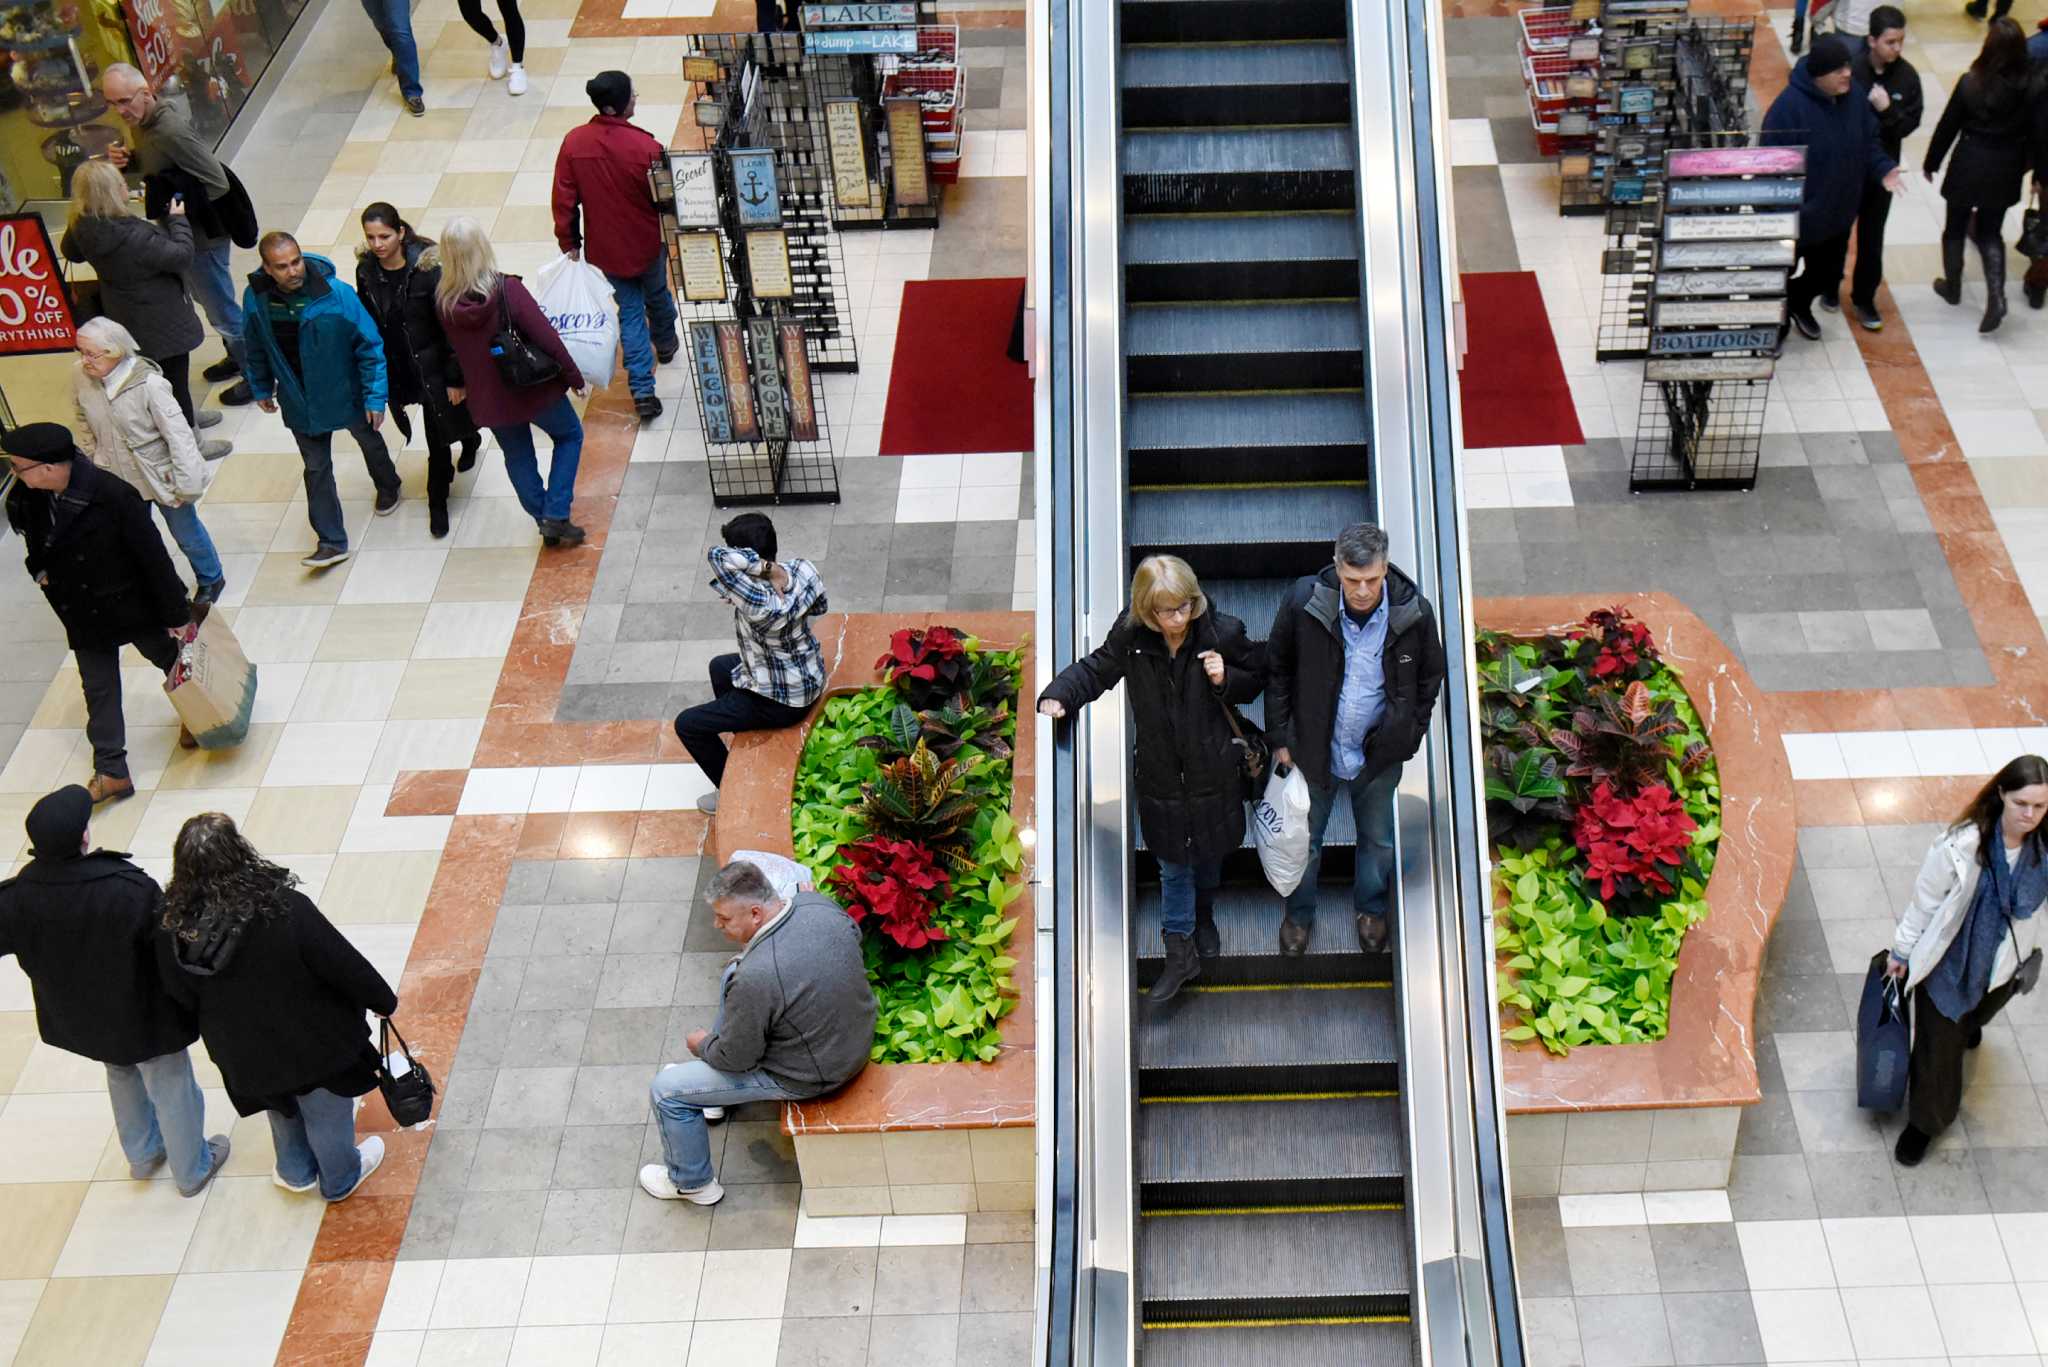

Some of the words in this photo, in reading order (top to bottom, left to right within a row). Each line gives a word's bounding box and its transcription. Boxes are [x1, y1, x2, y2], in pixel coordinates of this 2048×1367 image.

[822, 6, 893, 22] LAKE
[872, 34, 914, 48] LAKE
[675, 160, 711, 190] Secret
[0, 225, 48, 280] le
[0, 284, 59, 326] 0%
[34, 311, 63, 324] OFF
[0, 327, 72, 342] RYTHING!
[1655, 331, 1774, 350] BOATHOUSE
[694, 327, 730, 440] WELCOME
[720, 325, 751, 425] WELCOME
[752, 324, 786, 434] WELCOME
[784, 325, 809, 424] WELCOME
